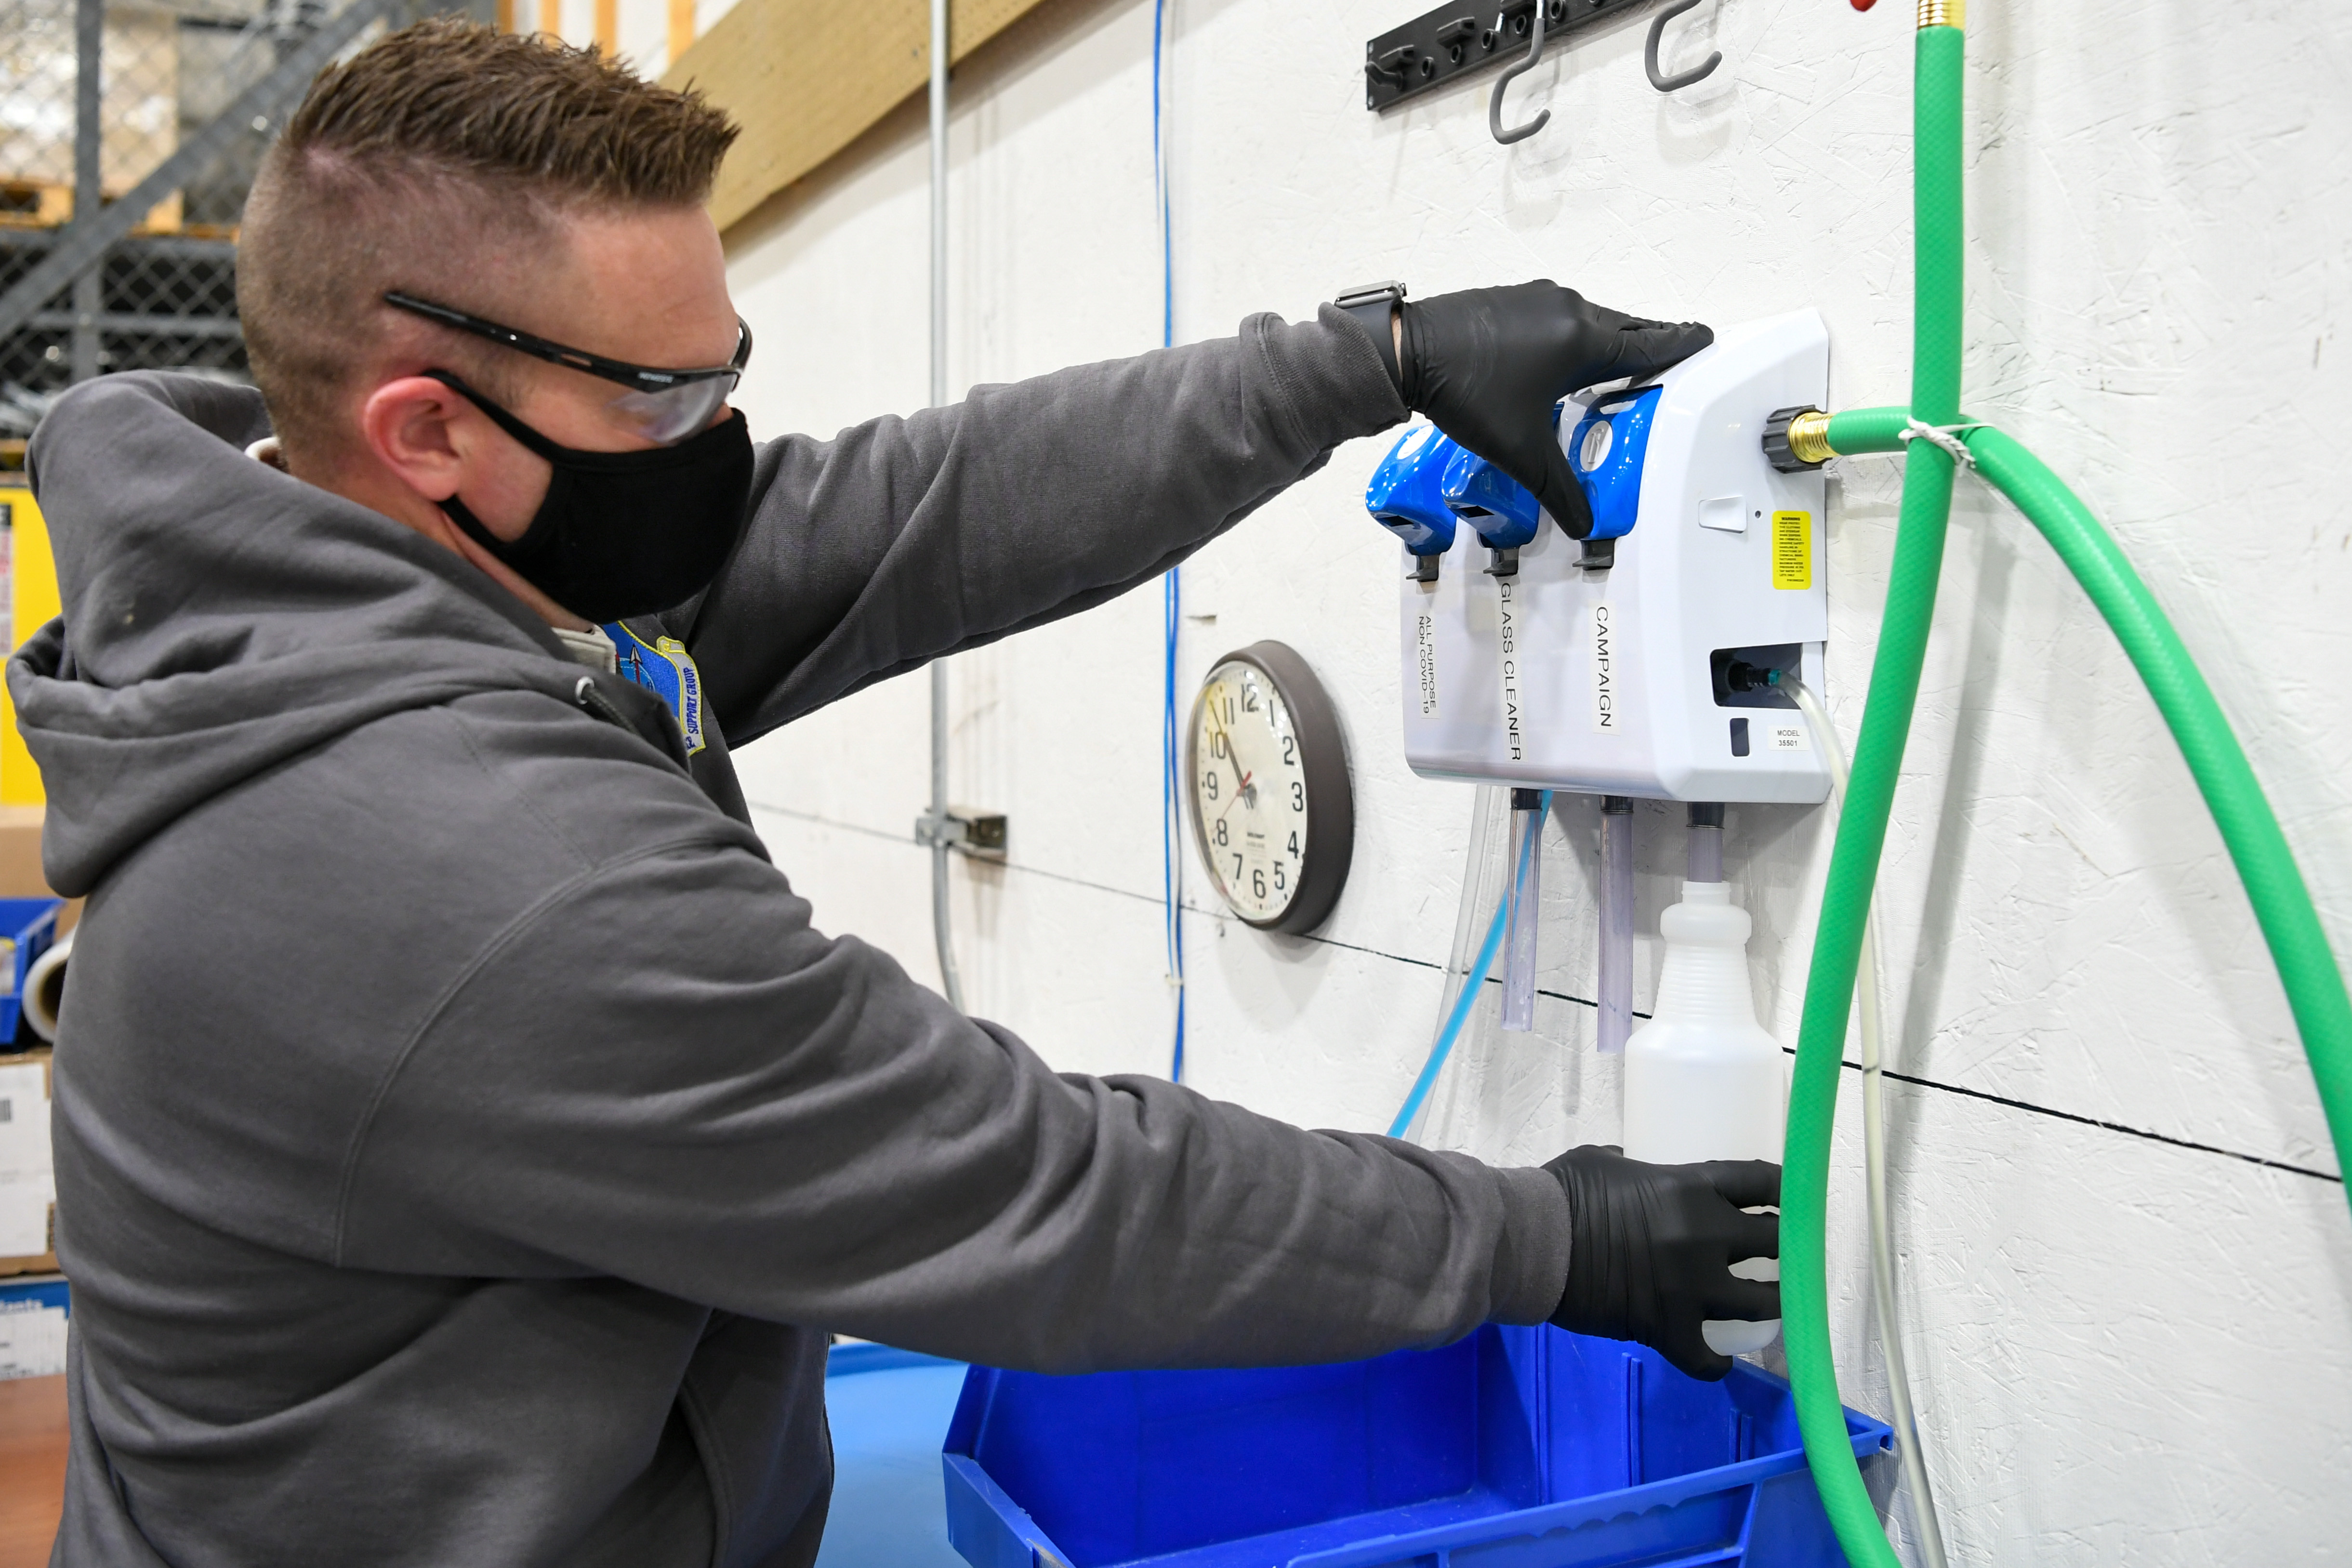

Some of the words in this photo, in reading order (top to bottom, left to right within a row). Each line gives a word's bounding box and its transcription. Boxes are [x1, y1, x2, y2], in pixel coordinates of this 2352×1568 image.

[1501, 582, 1514, 654] GLASS
[683, 667, 697, 695] GROUP
[1420, 649, 1429, 713] COVID-19
[1427, 644, 1436, 708] PURPOSE
[1596, 606, 1612, 727] CAMPAIGN
[1223, 697, 1235, 725] 11
[1241, 683, 1259, 712] 12
[1504, 660, 1521, 761] CLEANER
[687, 696, 699, 734] SUPPORT
[1269, 699, 1275, 727] 1
[1210, 731, 1227, 760] 10
[1282, 736, 1295, 766] 2
[1207, 772, 1218, 801] 9
[1291, 781, 1304, 812] 3
[1216, 818, 1229, 846] 8
[1287, 830, 1299, 859] 4
[1232, 853, 1242, 880] 7
[1273, 860, 1285, 890] 5
[1253, 869, 1266, 899] 6
